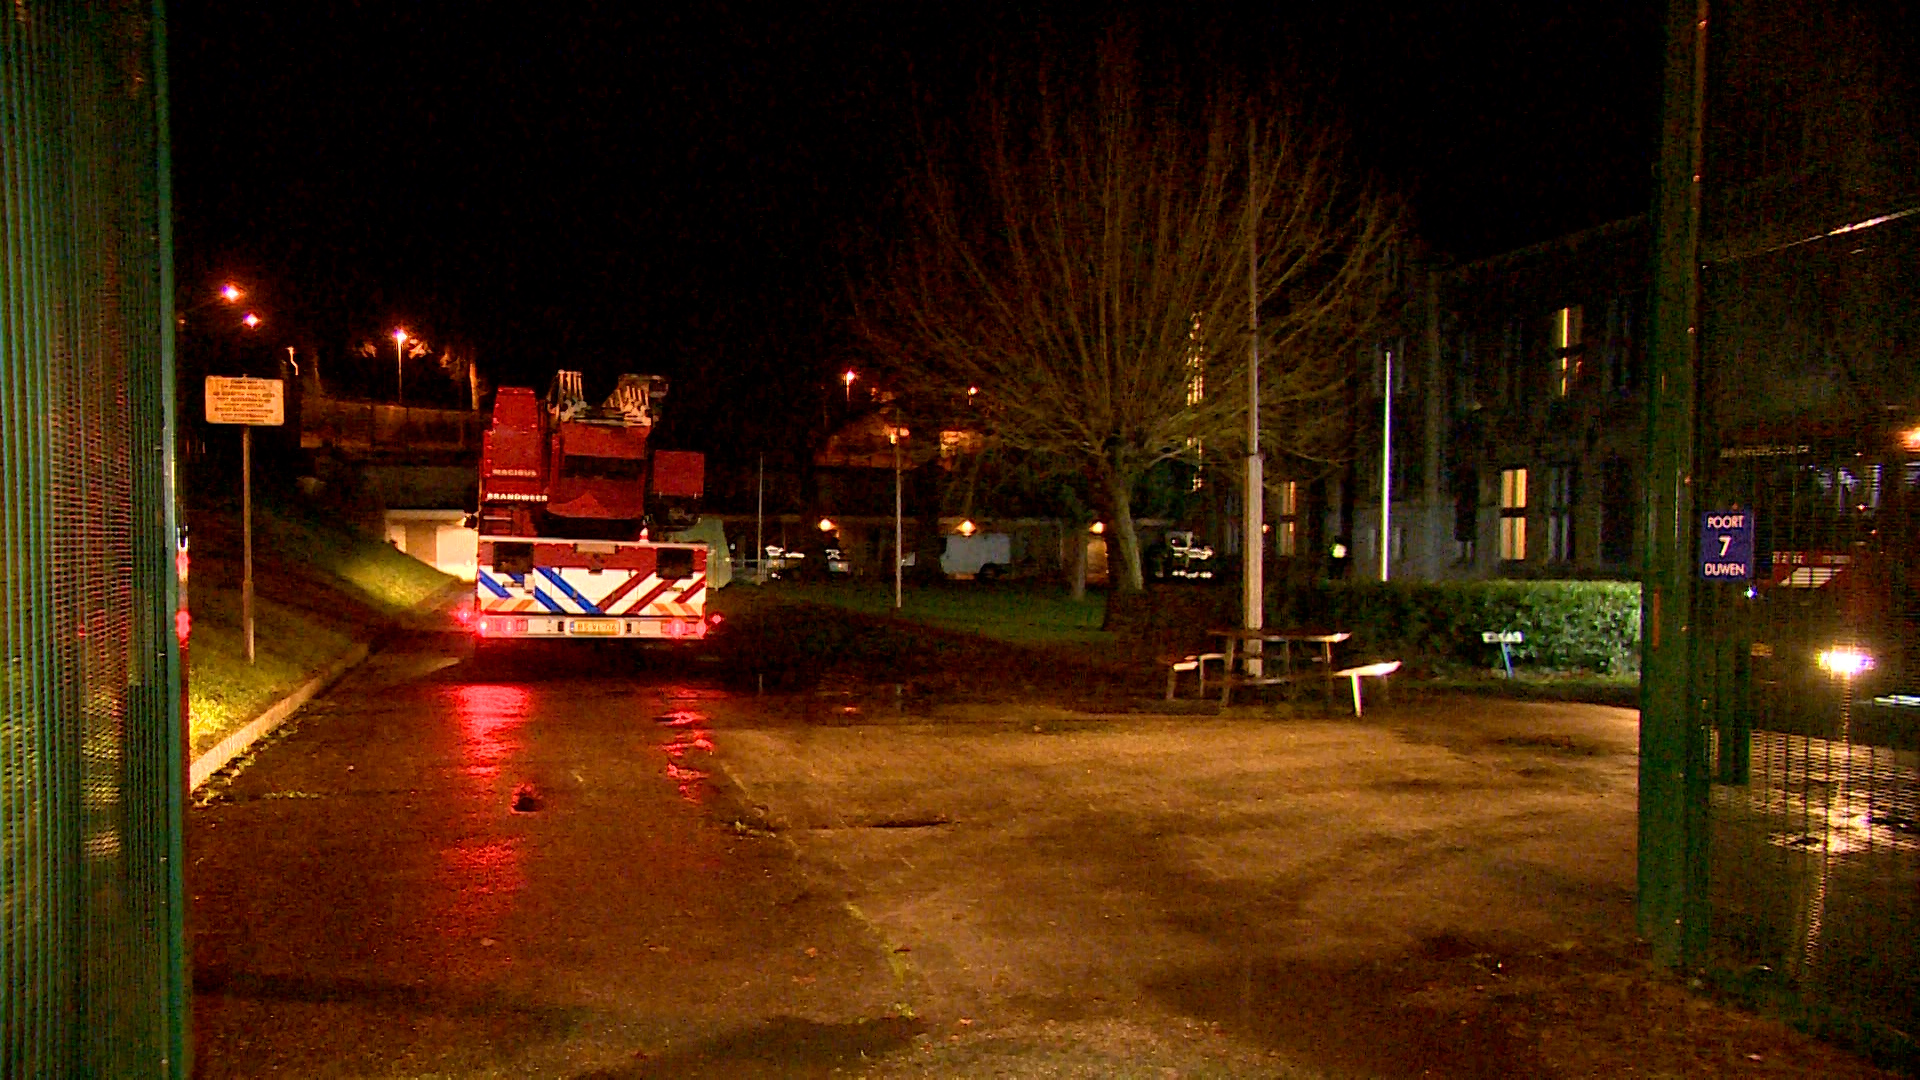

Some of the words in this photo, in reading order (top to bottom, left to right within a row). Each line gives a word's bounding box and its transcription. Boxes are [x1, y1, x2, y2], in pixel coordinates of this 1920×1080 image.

[487, 493, 548, 502] BRANDWEER
[1707, 515, 1744, 529] POORT
[1719, 535, 1731, 557] 7
[1704, 562, 1745, 576] DUWEN
